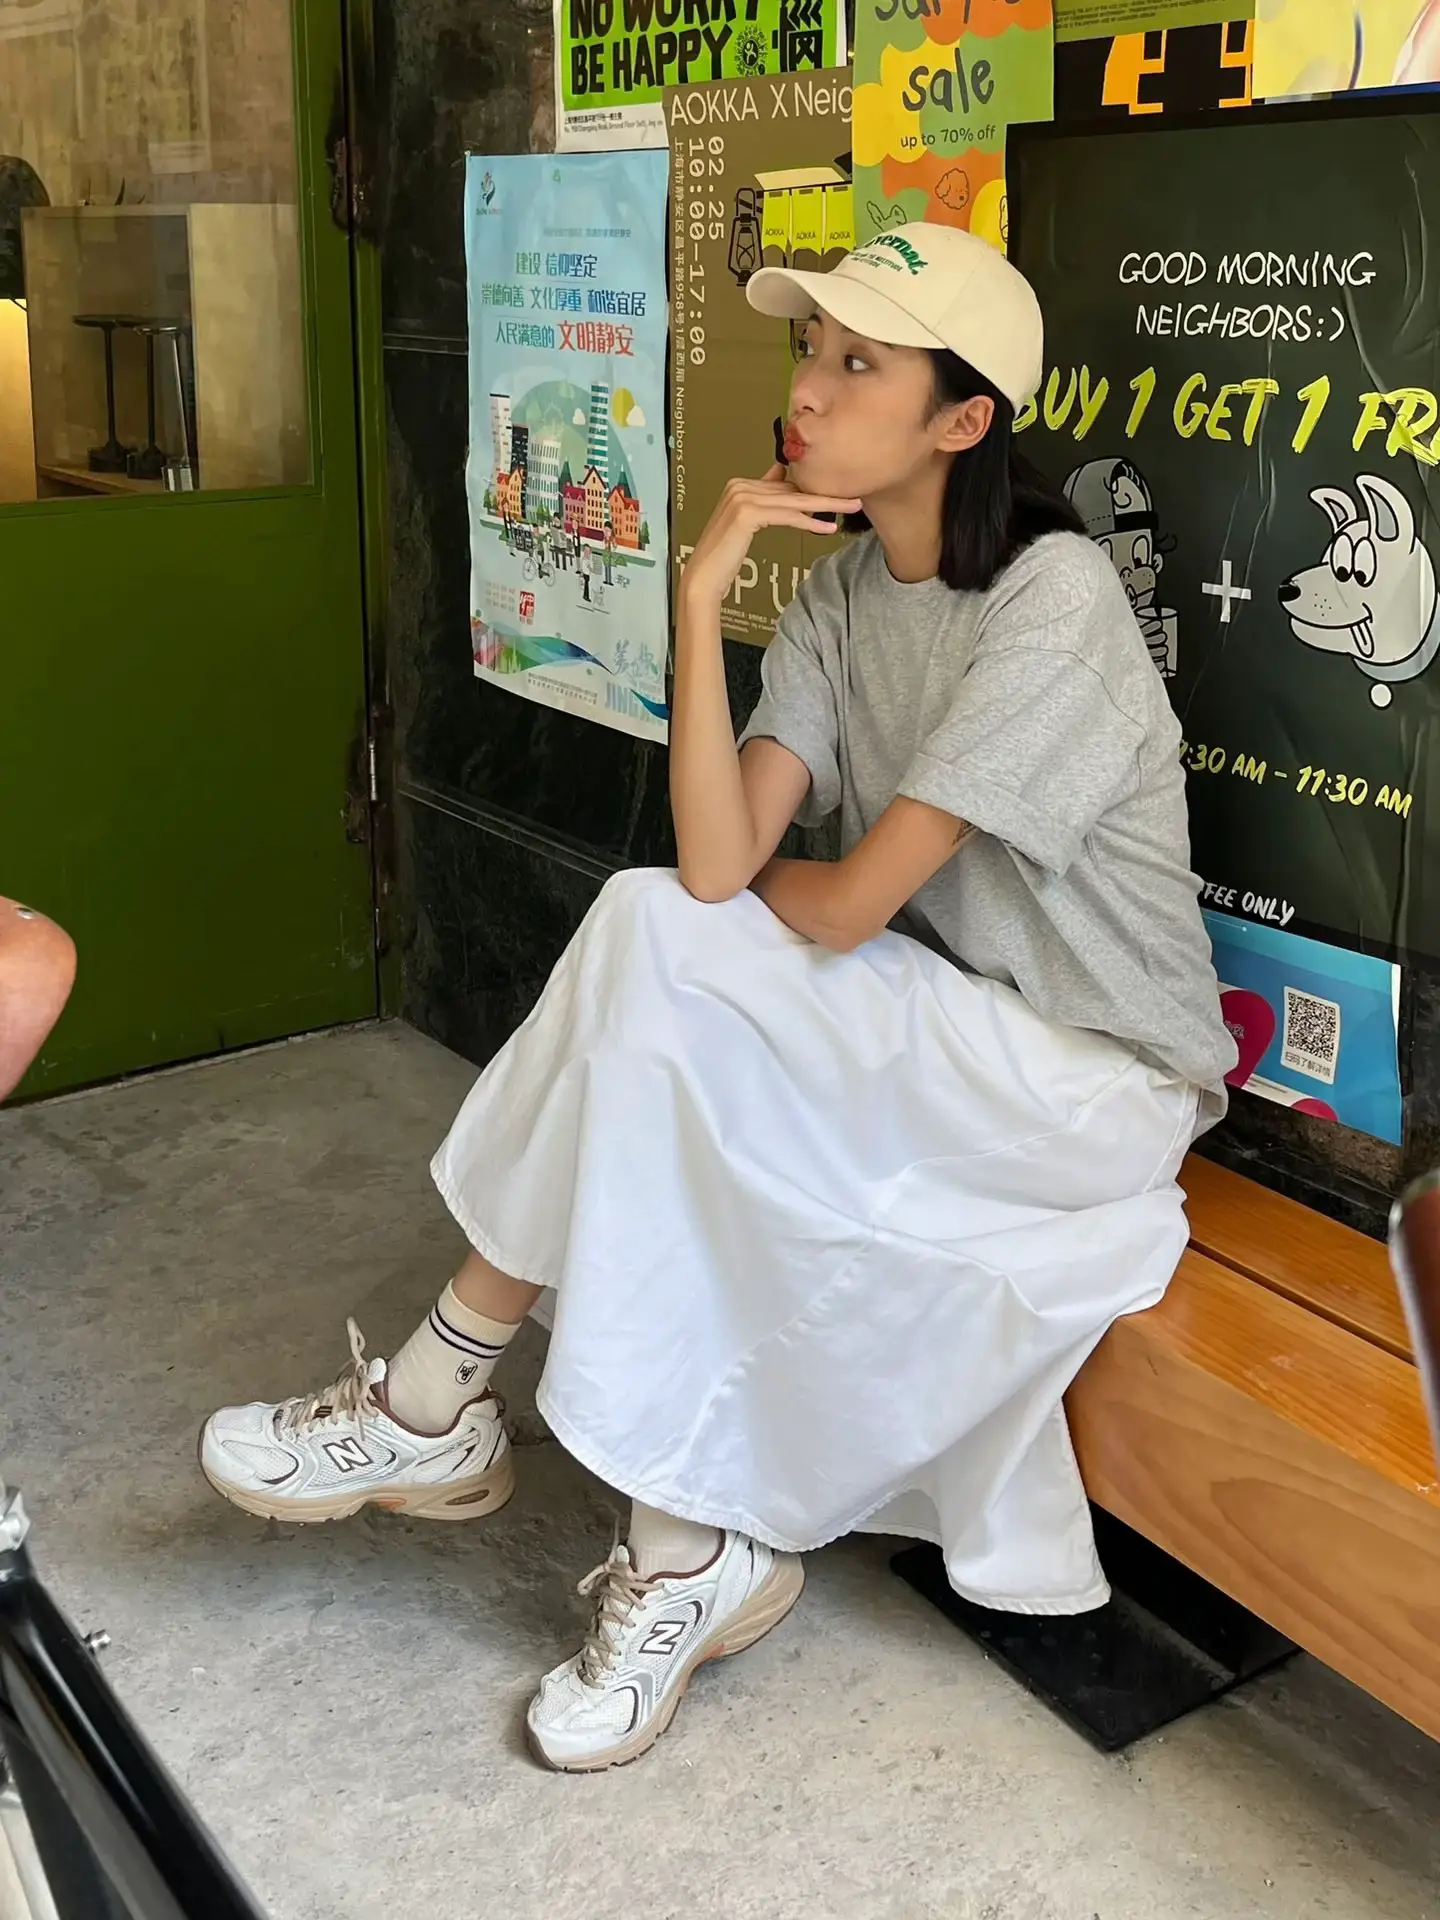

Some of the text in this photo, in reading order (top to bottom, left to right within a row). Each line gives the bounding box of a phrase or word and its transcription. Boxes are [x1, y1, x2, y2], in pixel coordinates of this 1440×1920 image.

[569, 0, 616, 39] NO
[570, 23, 737, 95] BE HAPPY
[902, 47, 994, 114] sale
[670, 86, 760, 127] AOKKA
[769, 83, 789, 119] X
[901, 124, 996, 149] up to 70% off
[708, 135, 725, 240] 02.25
[515, 251, 598, 279] 建设 信仰坚定
[1119, 250, 1376, 288] GOOD MORNING
[481, 284, 647, 317] 崇德向善 文化厚重 和谐宜居
[495, 320, 635, 356] 人民满意的 文明静安
[674, 387, 686, 460] Neighbors
[1125, 366, 1156, 439] 1
[1173, 372, 1280, 447] GET
[1292, 375, 1330, 453] 1
[1352, 387, 1440, 467] FR
[676, 464, 686, 511] Coffee
[1231, 753, 1267, 785] AM
[1296, 765, 1368, 806] 11:30
[1375, 784, 1413, 819] AM
[1241, 891, 1295, 927] ONLY
[322, 1437, 373, 1472] N
